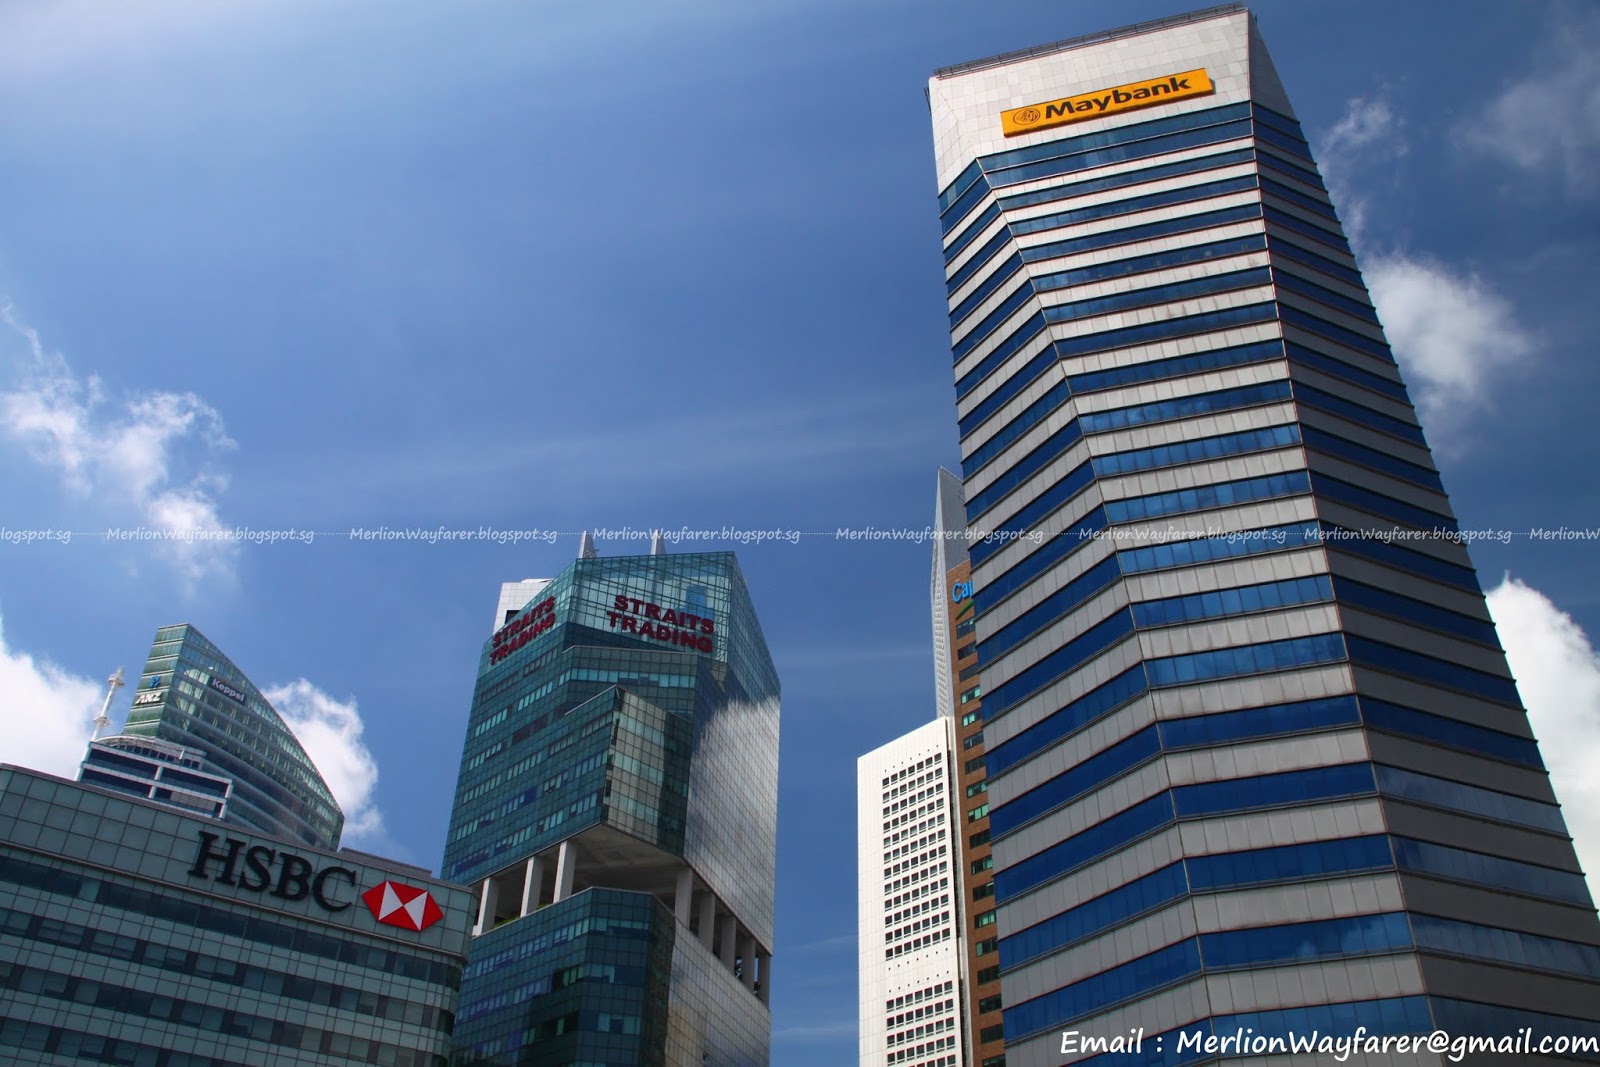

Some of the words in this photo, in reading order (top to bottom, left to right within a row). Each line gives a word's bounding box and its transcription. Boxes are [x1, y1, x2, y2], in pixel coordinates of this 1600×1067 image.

[1045, 77, 1191, 119] Maybank
[492, 596, 555, 648] STRAITS
[606, 610, 713, 653] TRADING
[614, 595, 715, 633] STRAITS
[489, 612, 556, 666] TRADING
[135, 691, 162, 704] ANZ
[212, 678, 245, 702] Keppel
[188, 830, 357, 912] HSBC
